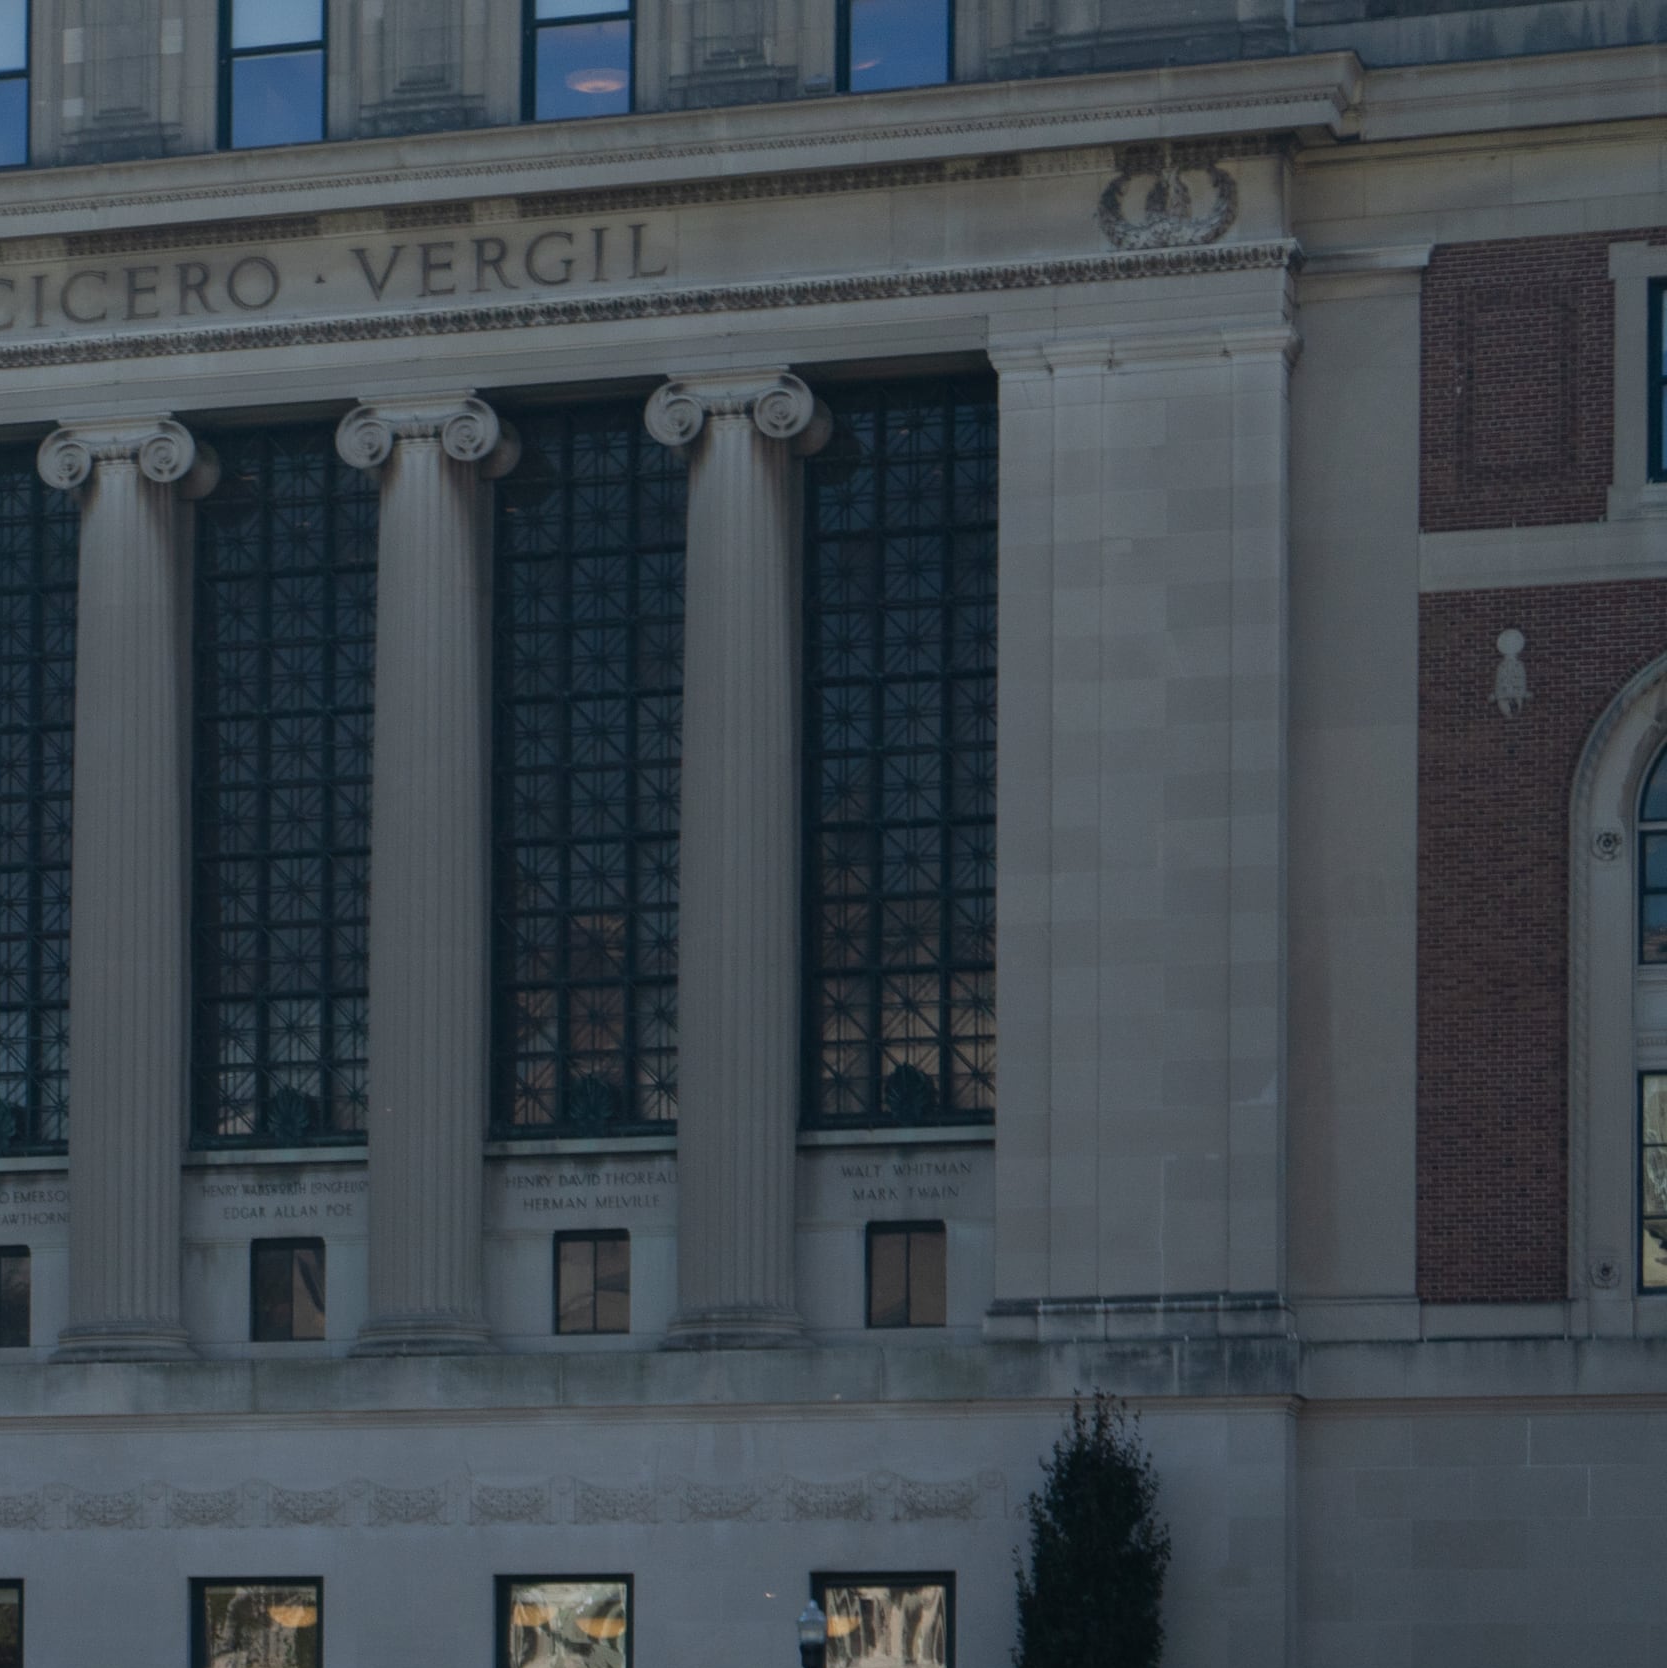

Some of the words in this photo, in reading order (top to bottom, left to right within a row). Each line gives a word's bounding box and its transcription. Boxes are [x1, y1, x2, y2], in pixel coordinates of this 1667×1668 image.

[349, 222, 668, 301] VERGIL
[841, 1164, 881, 1177] WALT
[893, 1161, 972, 1176] WHITMAN
[507, 1175, 556, 1190] HENRY
[559, 1173, 601, 1188] DAVID
[851, 1187, 897, 1200] MARK
[906, 1184, 958, 1198] TWAIN
[224, 1206, 266, 1219] EDGAR
[274, 1203, 317, 1217] ALLAN
[326, 1203, 354, 1216] POE
[523, 1198, 587, 1212] HERMAN
[595, 1194, 660, 1209] MELVILLE
